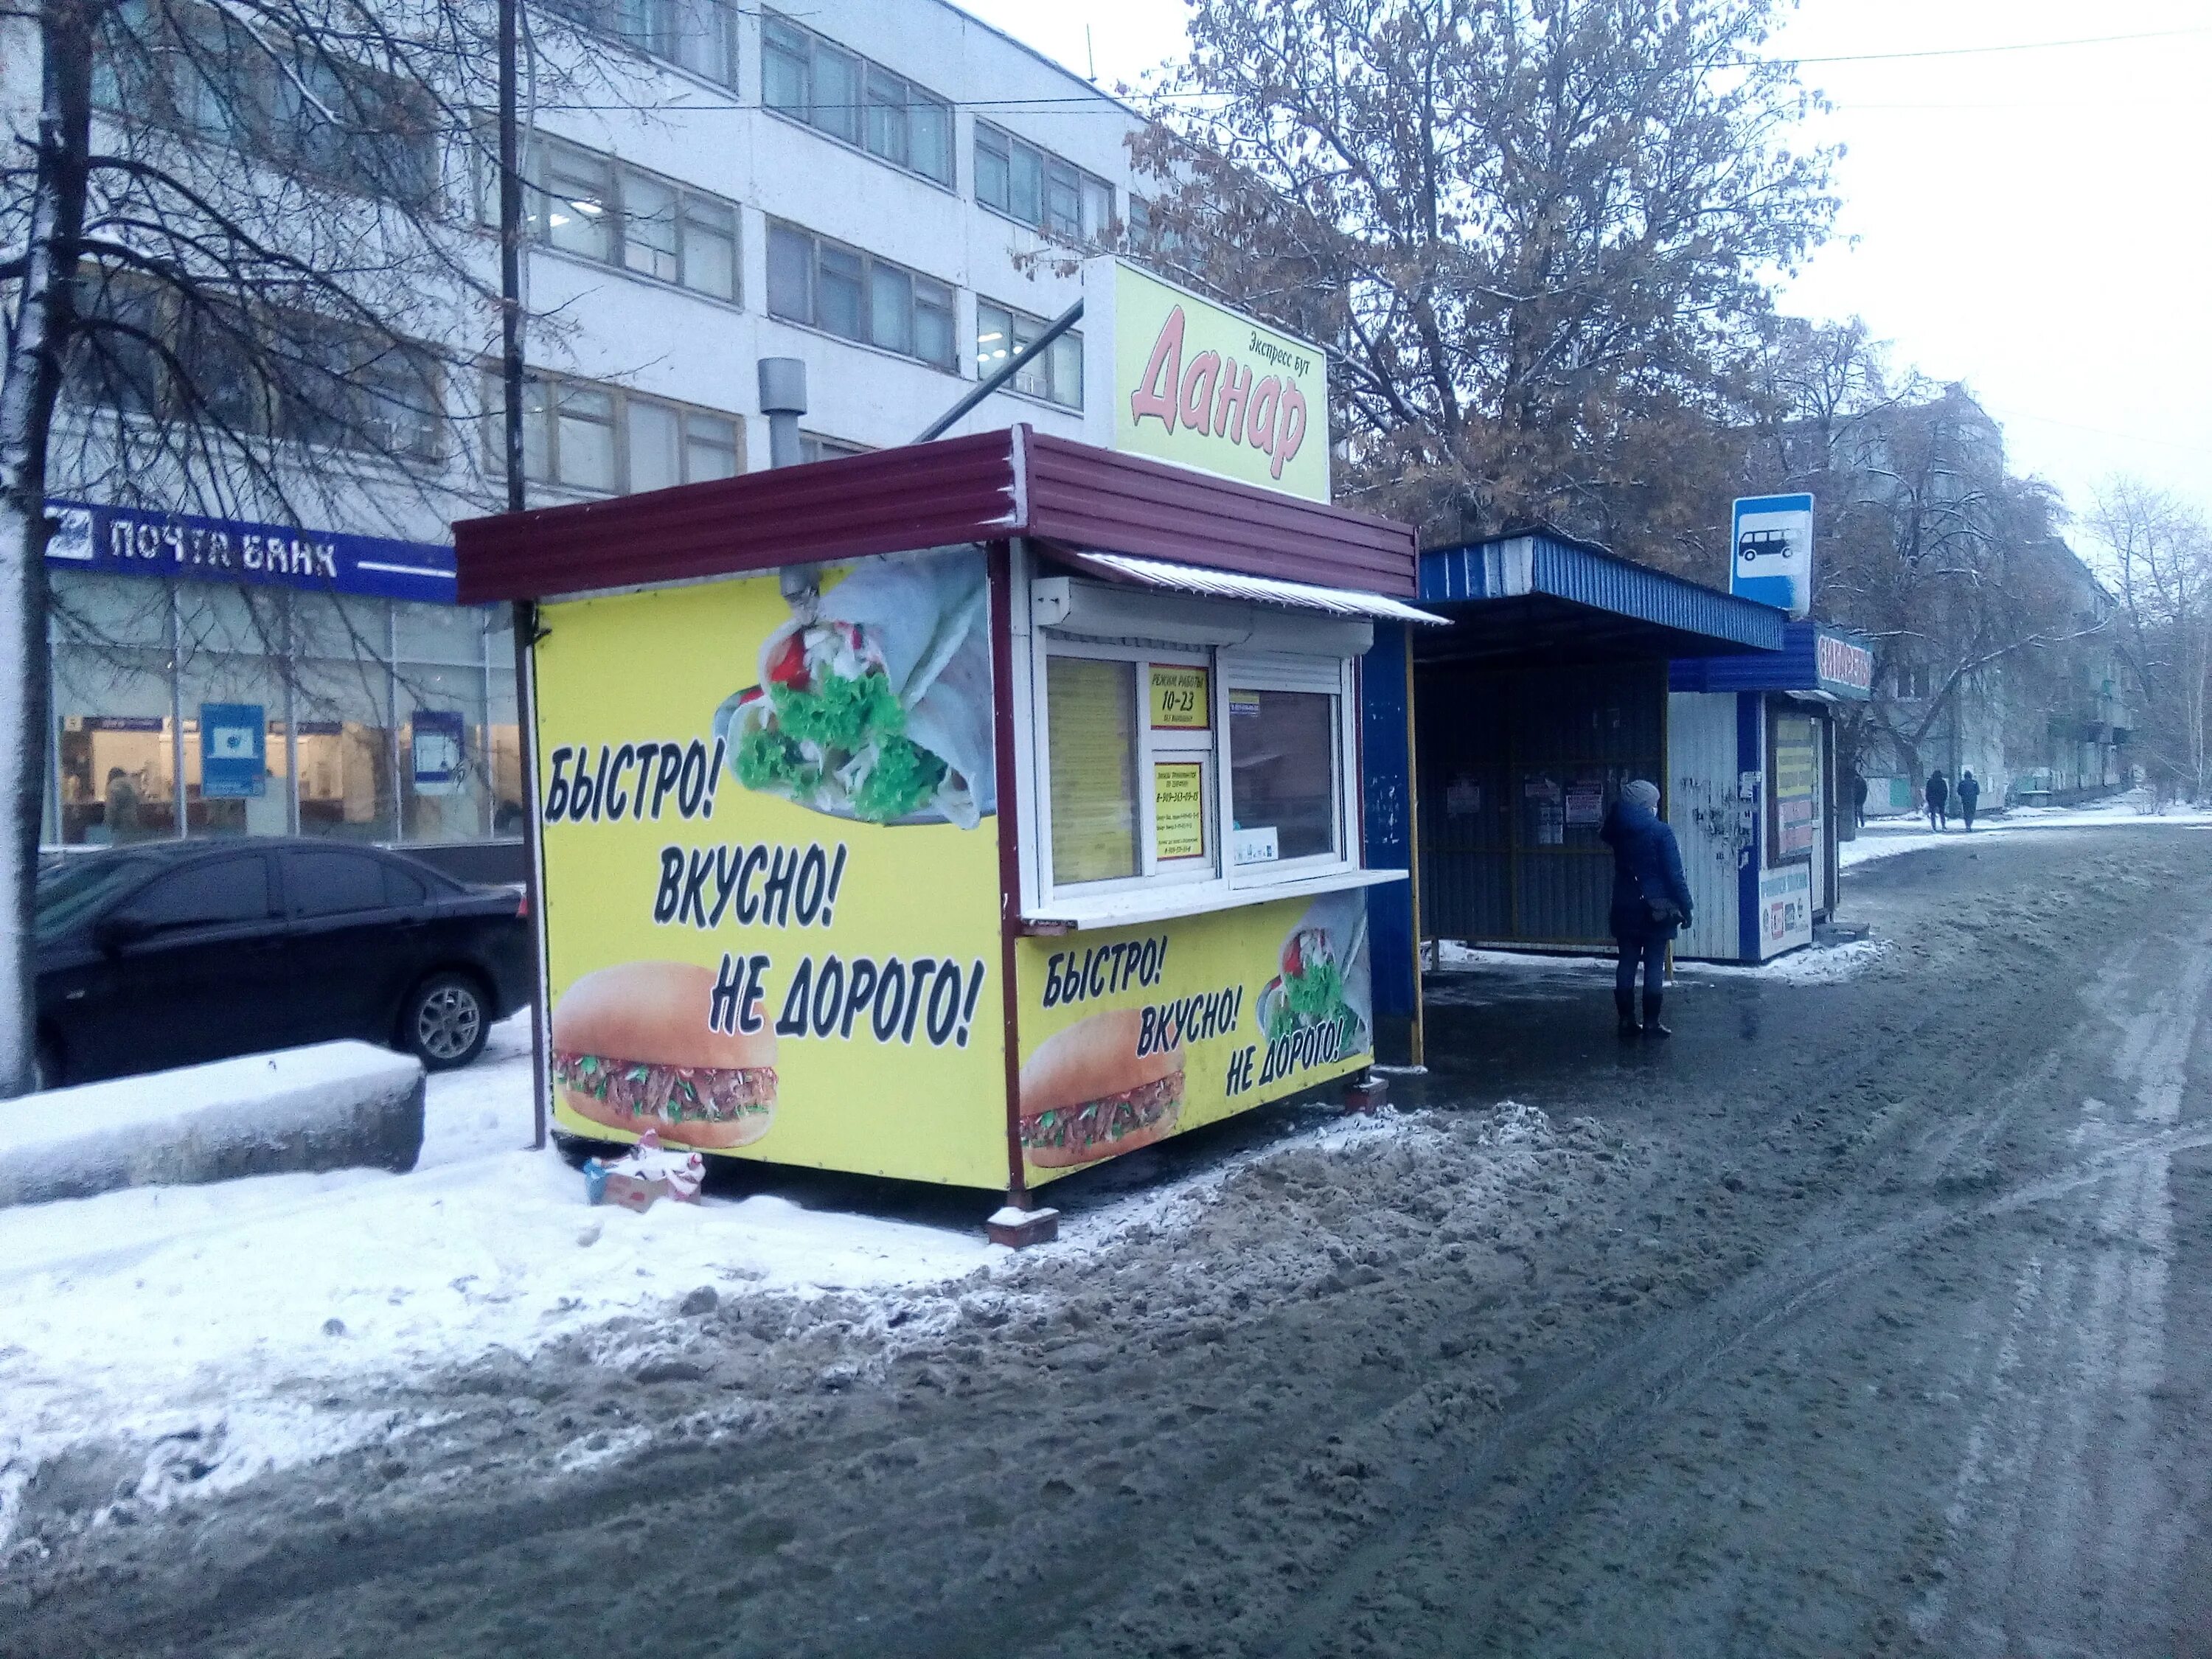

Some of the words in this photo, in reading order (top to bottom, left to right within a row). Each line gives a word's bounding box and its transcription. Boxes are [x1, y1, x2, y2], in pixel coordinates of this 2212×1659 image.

[1249, 330, 1293, 367] Экспресс
[1130, 304, 1307, 481] Данар
[109, 519, 231, 567] ПОЧТА
[242, 533, 338, 578] БАНК
[1162, 689, 1194, 712] 10-23
[546, 736, 727, 824] БЫСТРО!
[653, 844, 849, 929] ВКУСНО!
[709, 953, 771, 1036] НЕ
[774, 954, 986, 1048] ДОРОГО!
[1043, 936, 1167, 1009] БЫСТРО!
[1136, 985, 1243, 1059] ВКУСНО!
[1225, 1046, 1256, 1097] НЕ
[1259, 1018, 1343, 1087] ДОРОГО!
